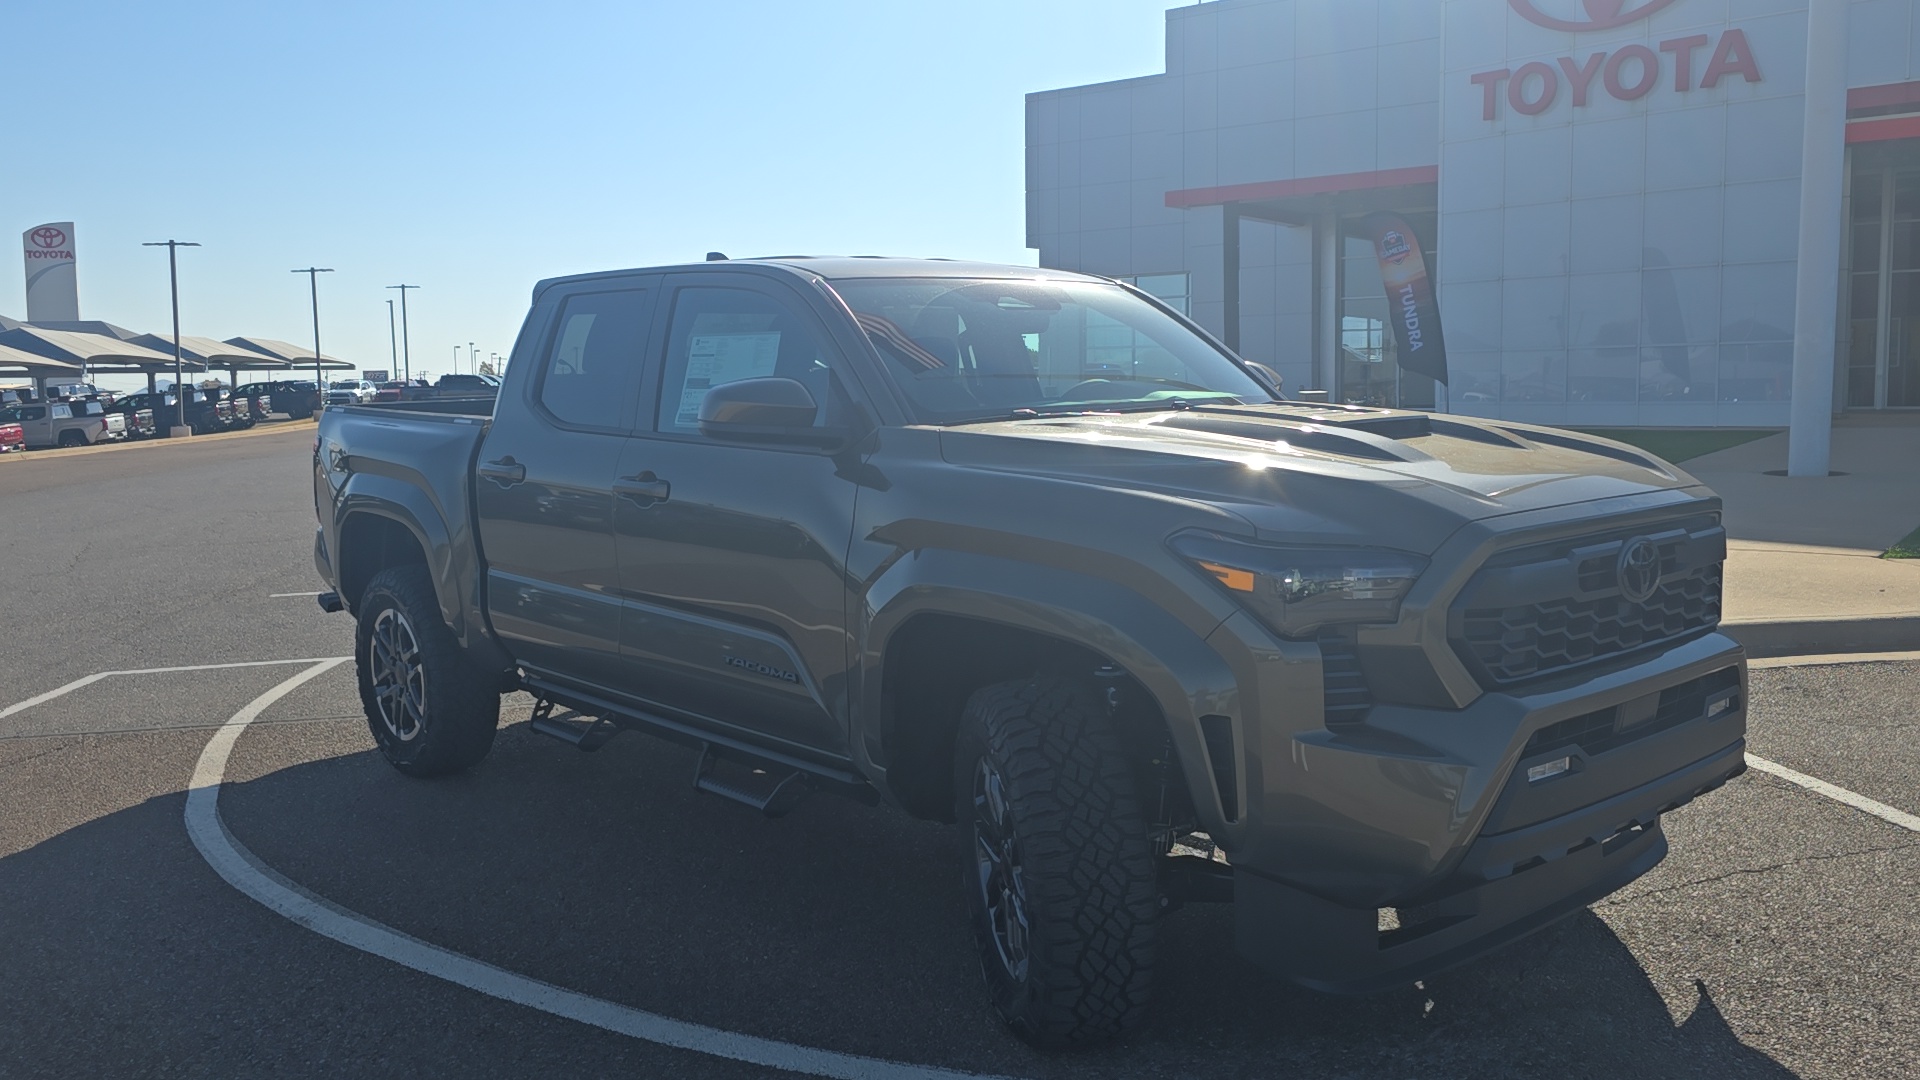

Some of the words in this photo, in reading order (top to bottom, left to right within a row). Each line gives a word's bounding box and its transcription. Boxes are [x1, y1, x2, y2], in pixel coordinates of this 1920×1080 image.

[1470, 28, 1762, 121] TOYOTA
[25, 250, 74, 259] TOYOTA
[1399, 283, 1424, 352] TUNDRA
[723, 655, 798, 683] TACOMA
